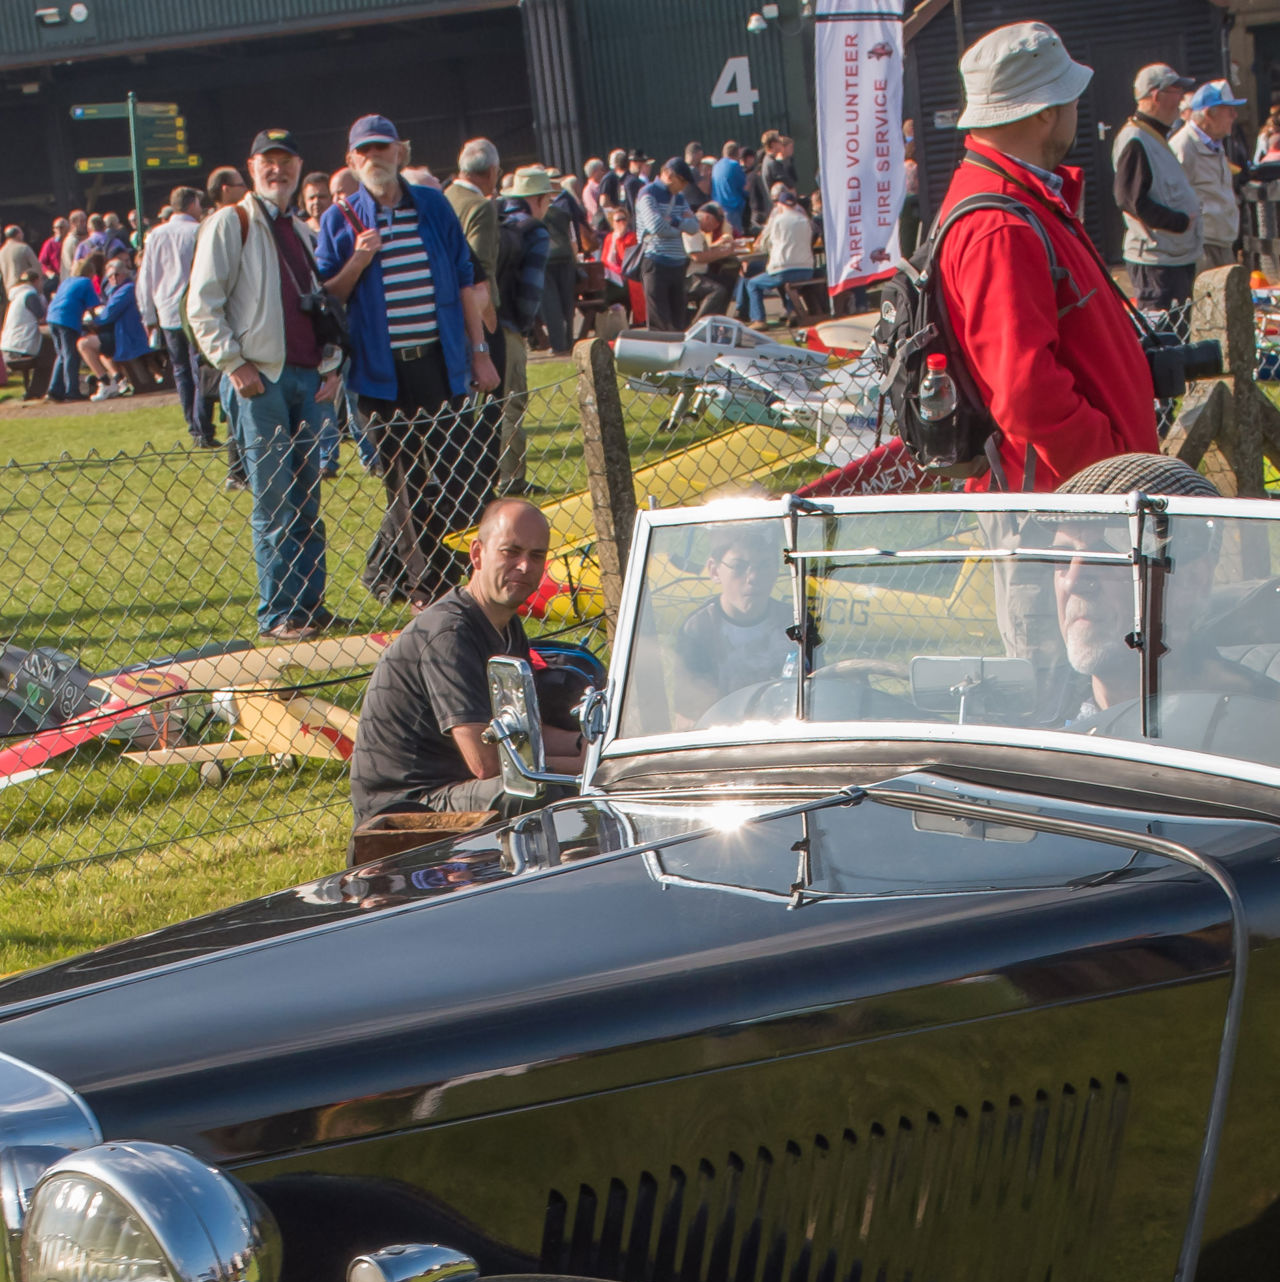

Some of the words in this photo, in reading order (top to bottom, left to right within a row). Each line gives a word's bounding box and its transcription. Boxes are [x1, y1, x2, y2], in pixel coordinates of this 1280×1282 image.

[711, 56, 759, 116] 4
[844, 33, 860, 169] VOLUNTEER
[874, 78, 891, 173] SERVICE
[846, 176, 863, 272] AIRFIELD
[877, 179, 892, 228] FIRE
